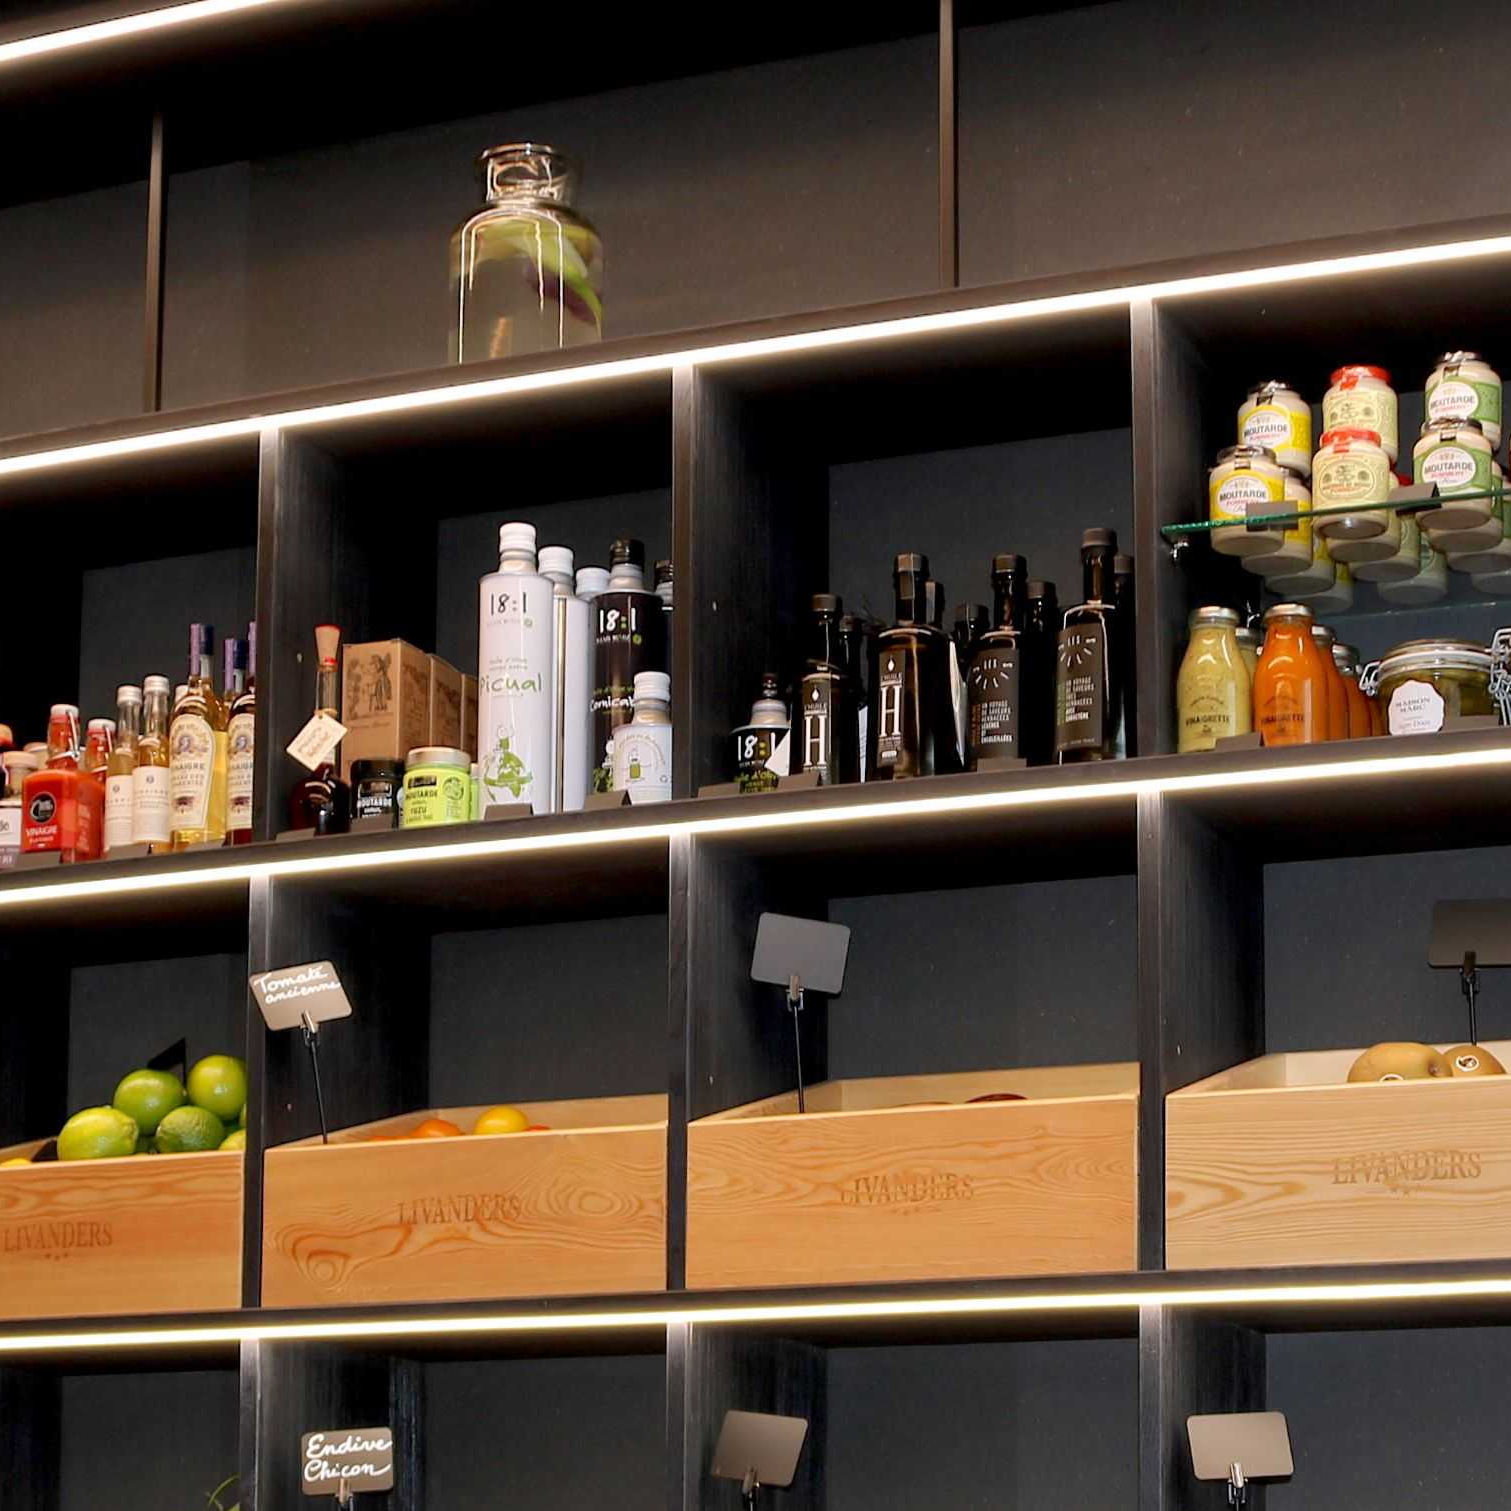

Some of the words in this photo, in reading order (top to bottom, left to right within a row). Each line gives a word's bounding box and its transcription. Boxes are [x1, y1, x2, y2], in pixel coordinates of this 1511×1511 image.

[1423, 462, 1474, 473] MOUTARDE
[1219, 489, 1267, 502] MOUTARDE
[254, 966, 330, 994] Tomate
[1332, 1149, 1482, 1186] LIVANDERS
[398, 1194, 521, 1225] LIVANDERS
[4, 1222, 113, 1254] LIVANDERS
[306, 1433, 393, 1459] Endive
[304, 1459, 392, 1482] Chicon
